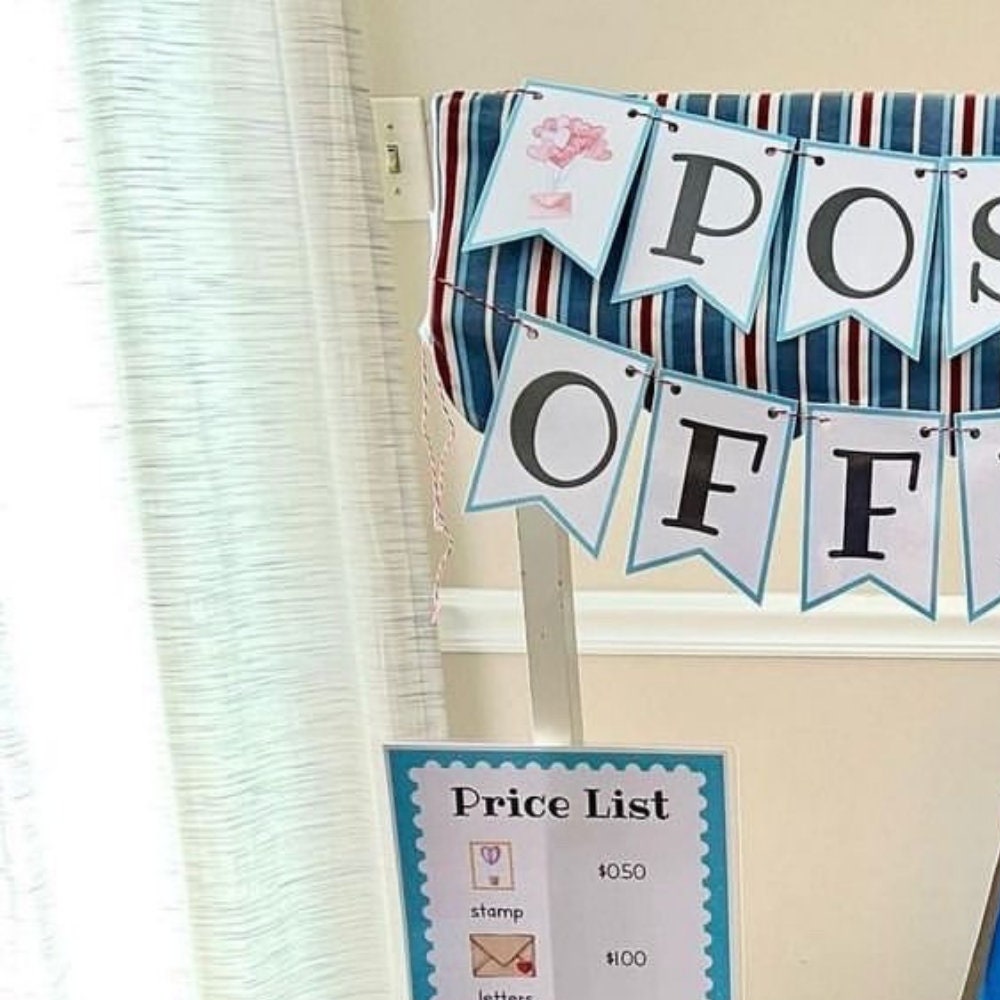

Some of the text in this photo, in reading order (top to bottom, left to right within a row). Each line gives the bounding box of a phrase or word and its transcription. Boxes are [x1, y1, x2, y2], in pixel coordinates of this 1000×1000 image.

[450, 786, 670, 821] Price List
[470, 903, 524, 924] stamp
